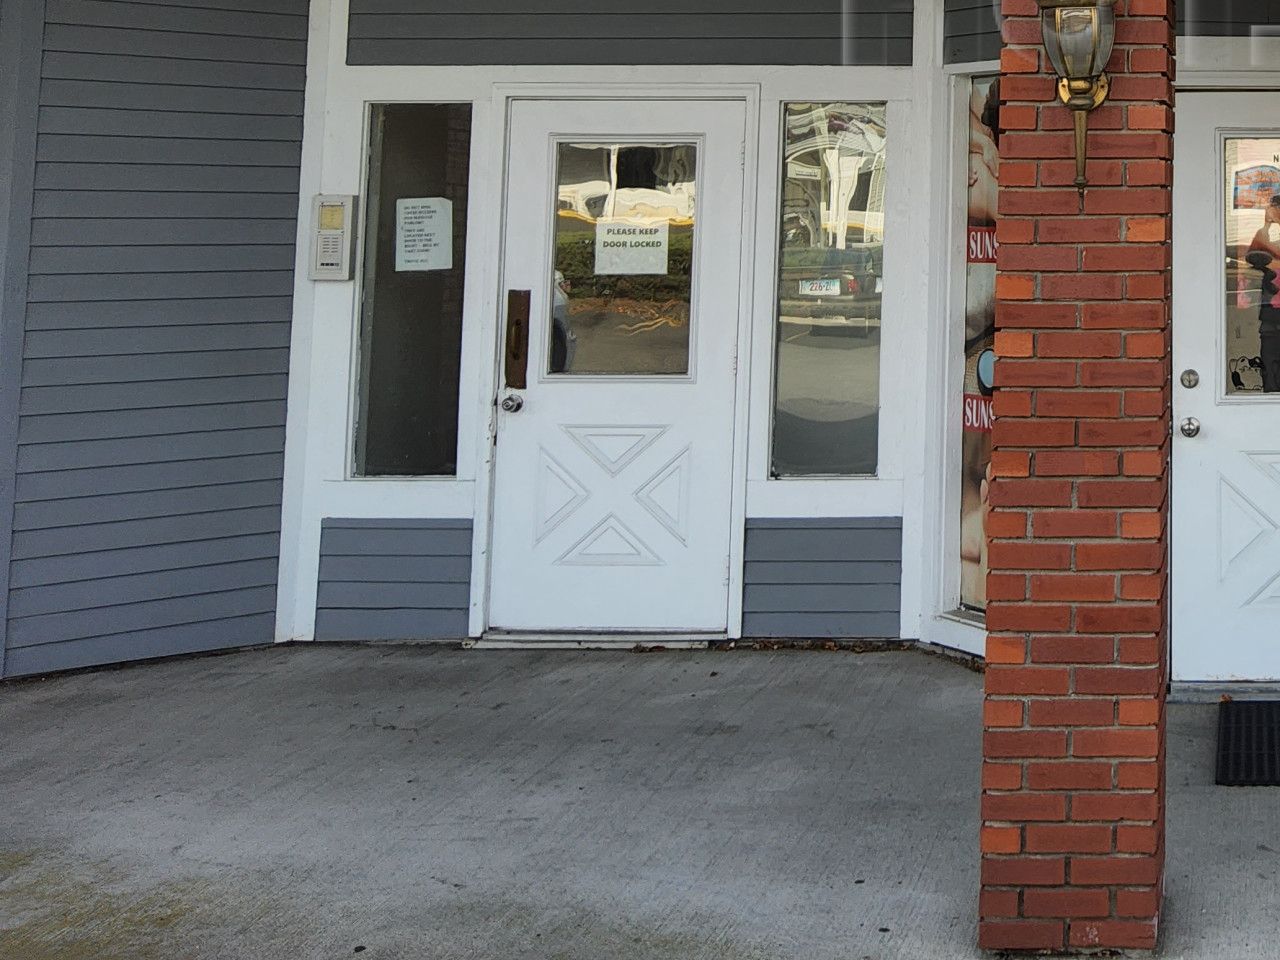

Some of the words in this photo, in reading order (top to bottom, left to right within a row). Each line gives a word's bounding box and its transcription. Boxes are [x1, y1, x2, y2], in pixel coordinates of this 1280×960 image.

[606, 228, 637, 236] PLEASE
[639, 228, 660, 236] KEEP
[602, 240, 628, 249] DOOR
[629, 240, 662, 249] LOCKED
